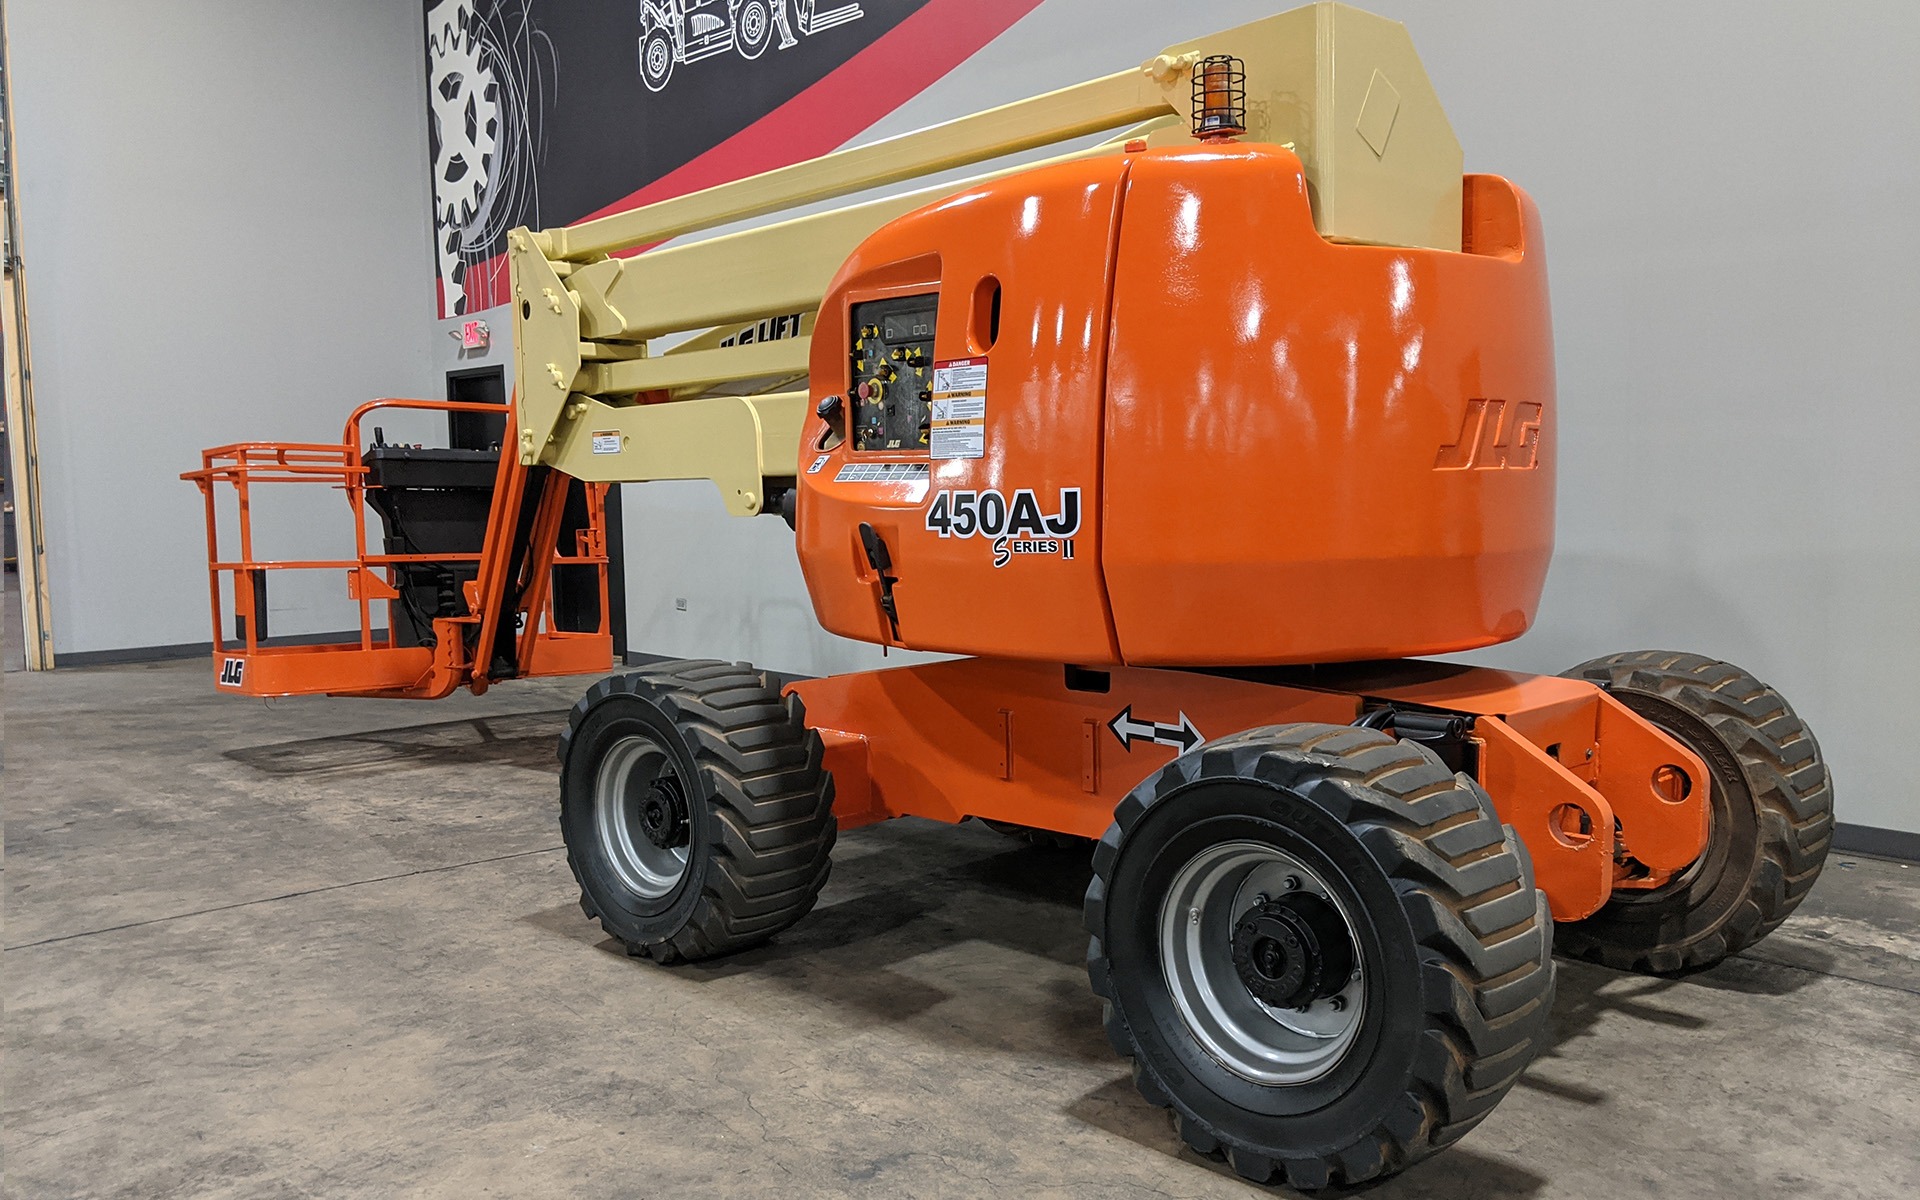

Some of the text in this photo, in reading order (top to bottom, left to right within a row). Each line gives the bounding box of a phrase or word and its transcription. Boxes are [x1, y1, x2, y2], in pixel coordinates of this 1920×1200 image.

[757, 313, 804, 343] LIFT
[886, 439, 901, 449] JLG
[1432, 398, 1543, 472] JLG
[926, 487, 1081, 539] 450AJ
[220, 658, 245, 687] JLG
